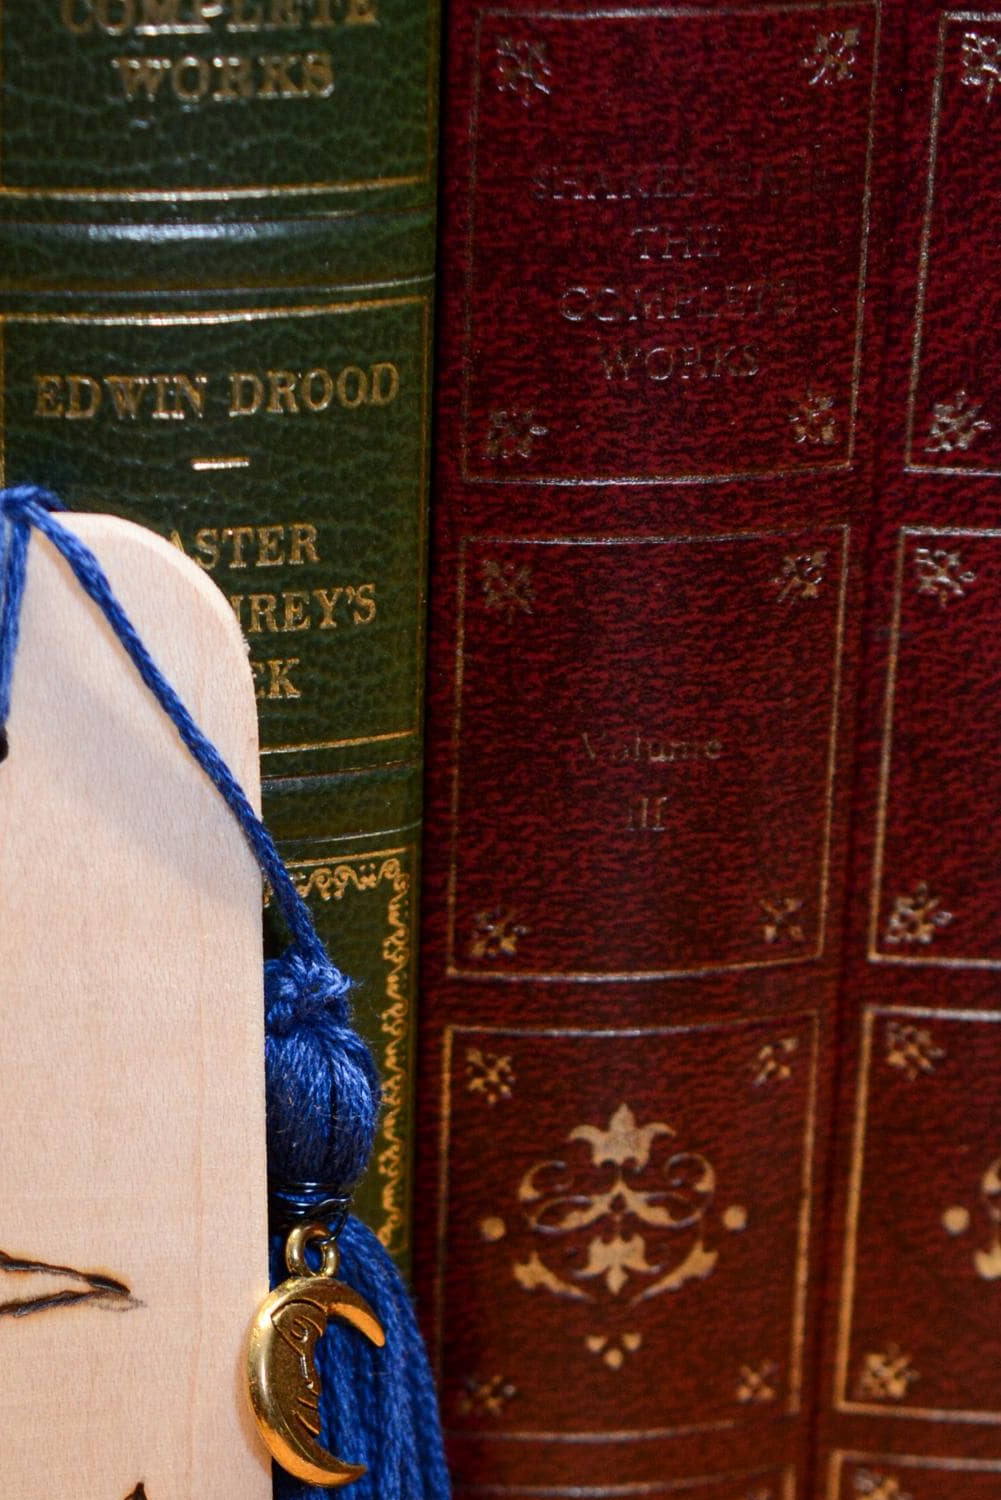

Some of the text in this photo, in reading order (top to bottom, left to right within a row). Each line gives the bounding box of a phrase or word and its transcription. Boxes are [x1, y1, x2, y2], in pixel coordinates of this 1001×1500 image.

[110, 51, 334, 101] WORKS
[34, 362, 400, 420] EDWIN DROOD
